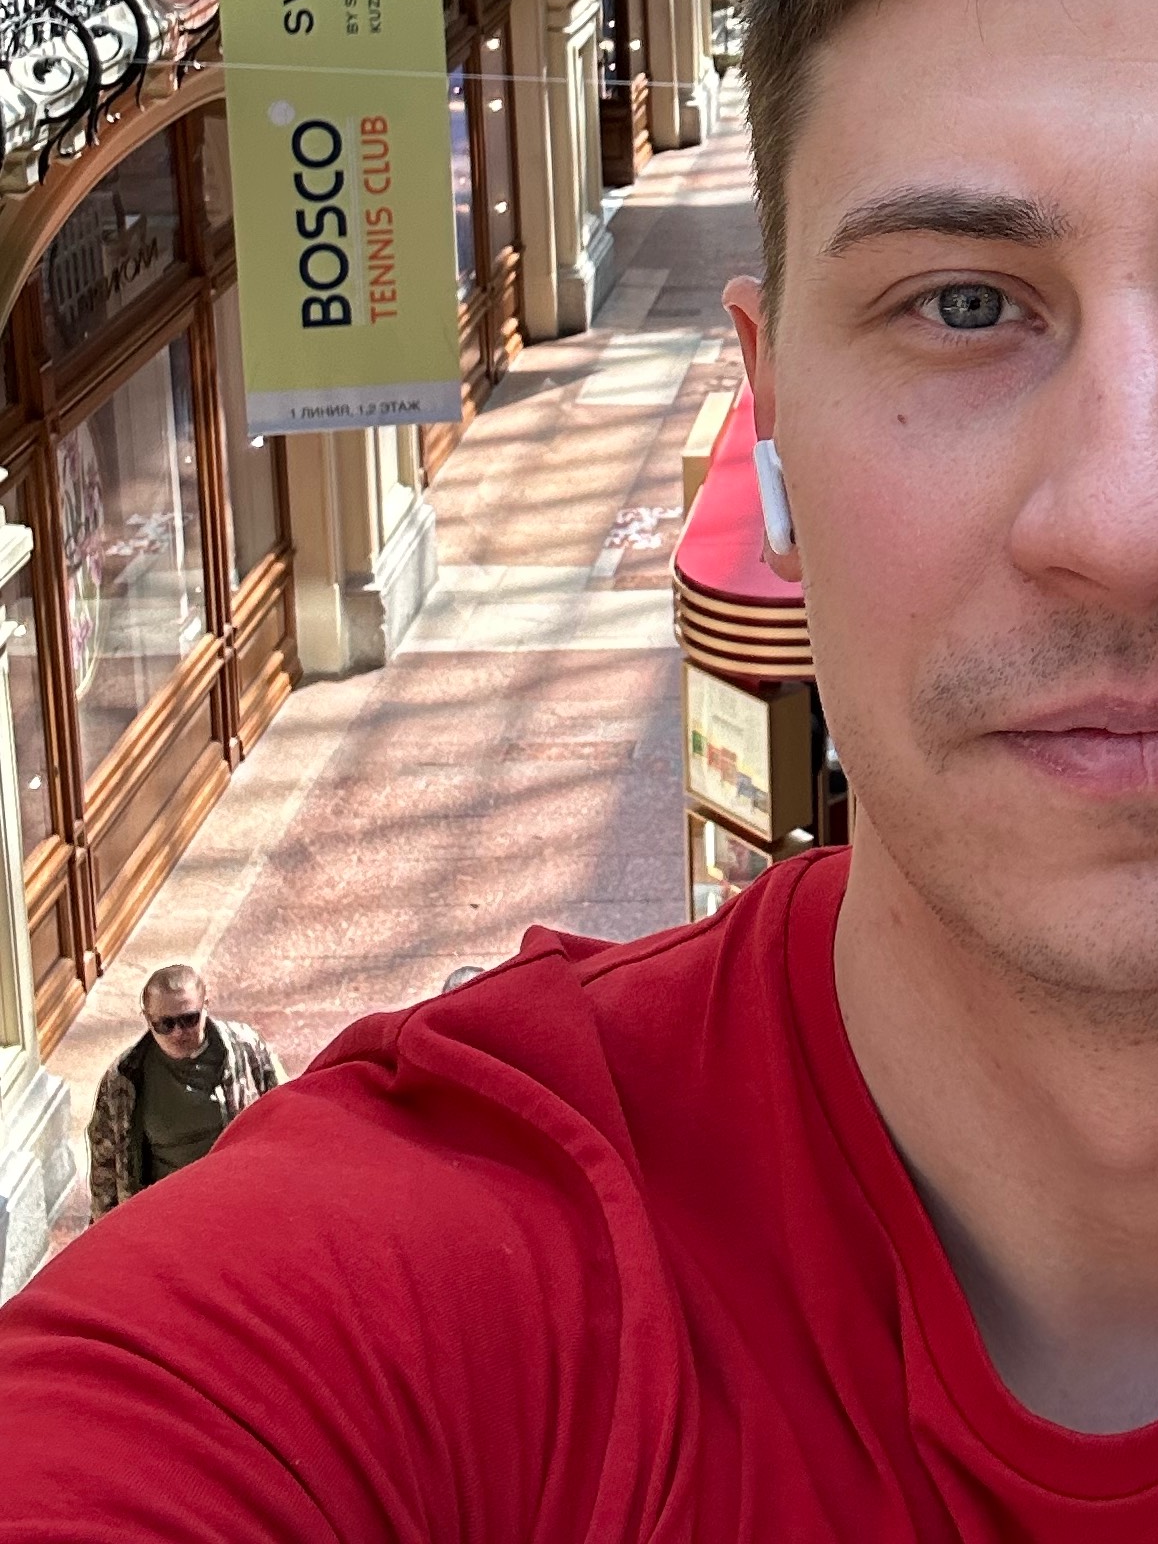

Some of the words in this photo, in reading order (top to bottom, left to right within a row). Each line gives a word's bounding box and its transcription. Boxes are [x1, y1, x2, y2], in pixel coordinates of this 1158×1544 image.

[346, 13, 359, 35] BY
[360, 115, 392, 195] CLUB
[292, 119, 352, 328] BOSCO
[366, 206, 398, 325] TENNIS
